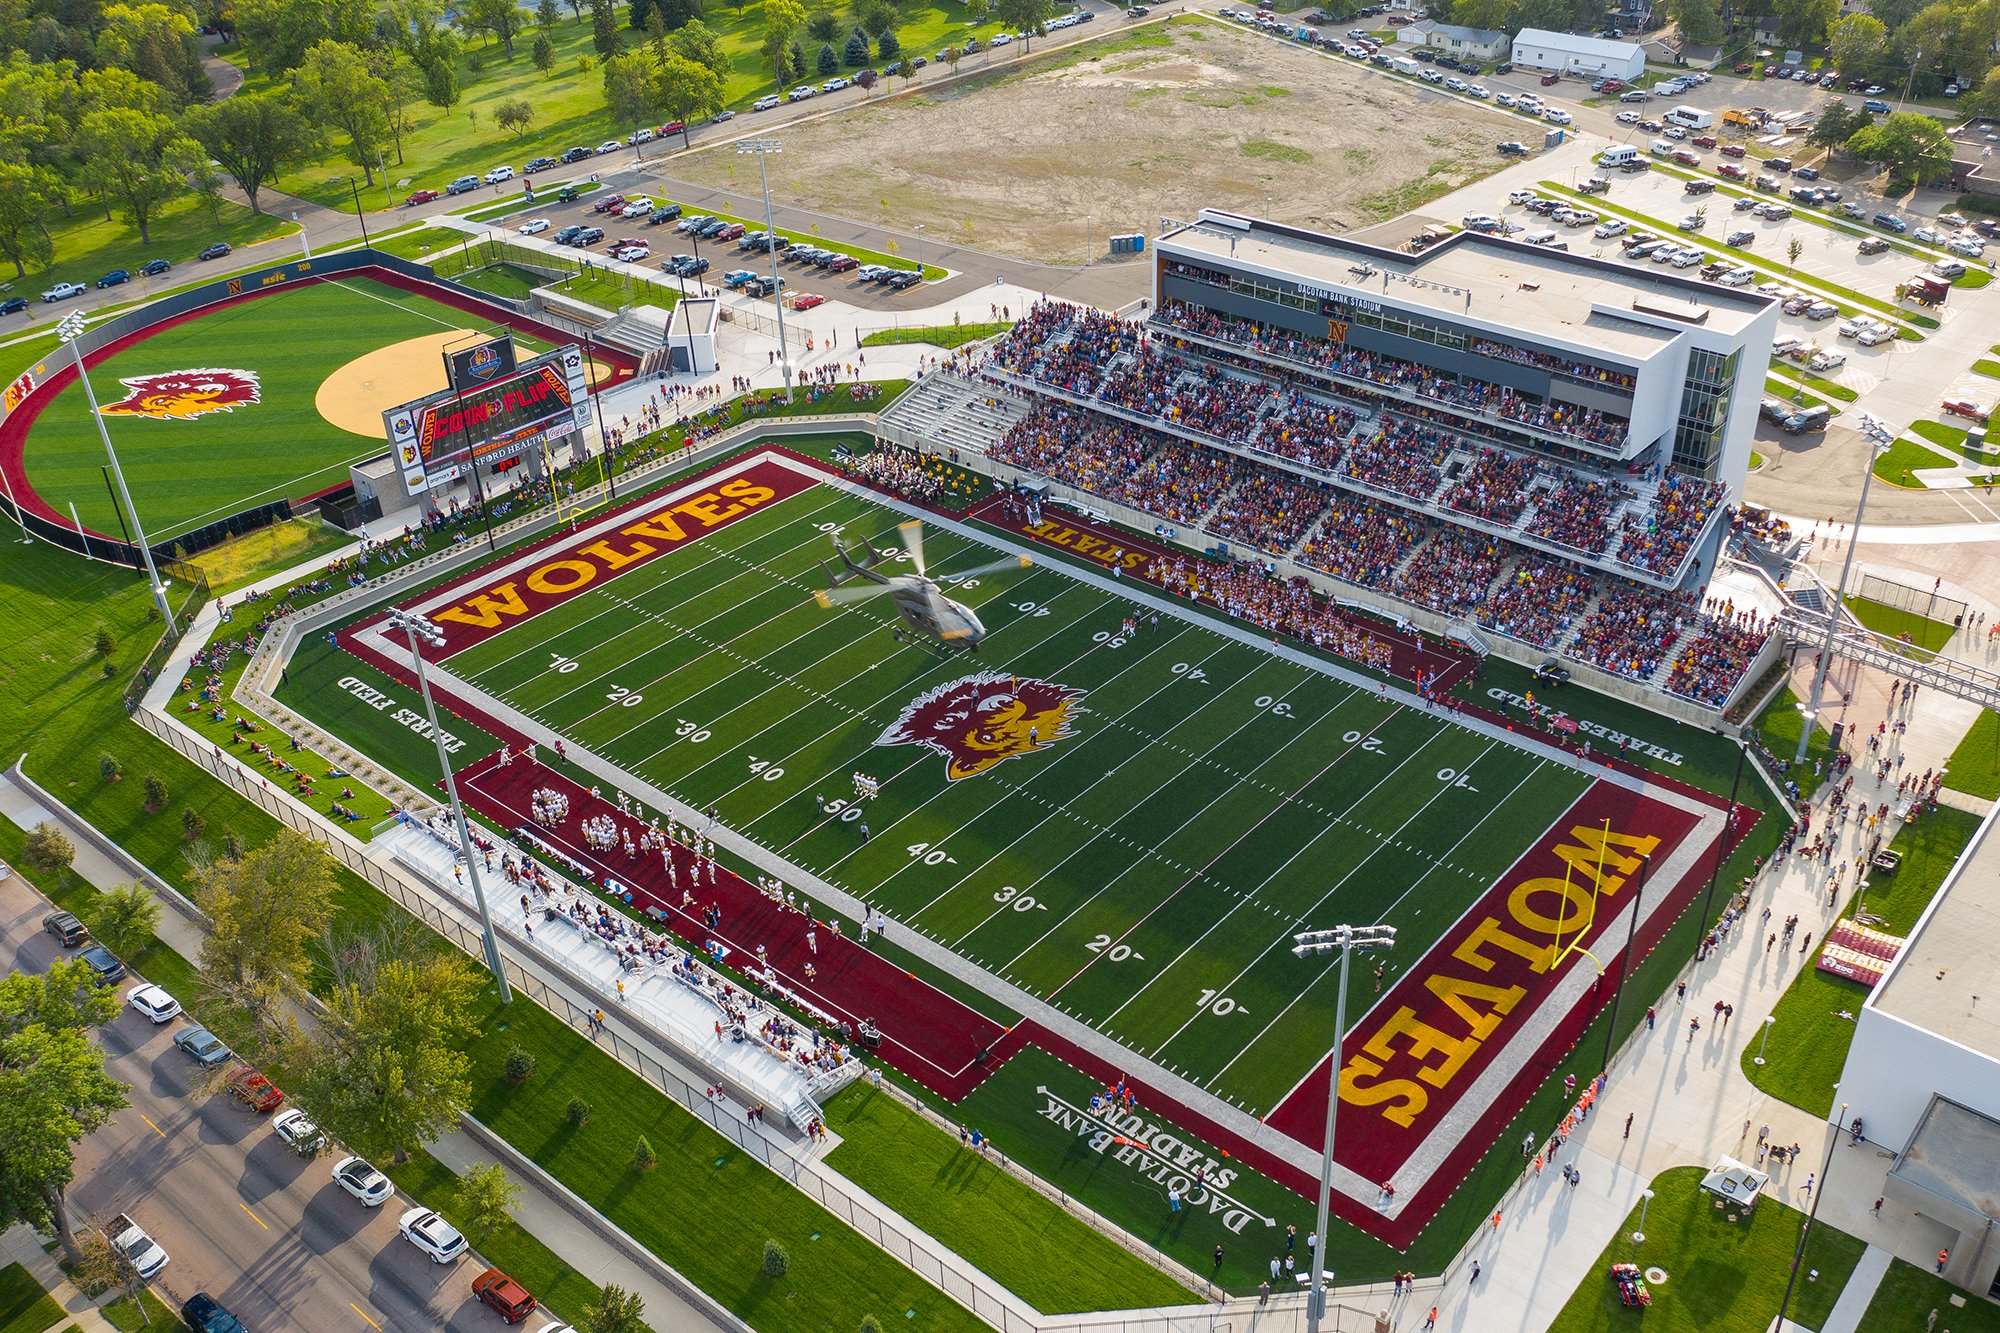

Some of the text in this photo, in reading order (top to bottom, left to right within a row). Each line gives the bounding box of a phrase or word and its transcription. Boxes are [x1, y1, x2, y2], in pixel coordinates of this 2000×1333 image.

[297, 262, 311, 271] 200
[227, 279, 243, 295] N
[1297, 284, 1381, 312] DACOTAH BANK STADIUM
[1328, 319, 1348, 344] N
[543, 370, 571, 403] WOLVES
[434, 380, 552, 439] COIN FLIP
[421, 412, 436, 457] WOLVES
[461, 449, 506, 473] SANFORD
[508, 433, 545, 455] HEALTH
[432, 479, 775, 629] WOLVES
[881, 547, 914, 562] 20
[1022, 519, 1148, 569] STATE
[1018, 601, 1051, 617] 40
[1092, 631, 1127, 649] 50
[549, 657, 579, 674] 10
[1170, 662, 1206, 680] 40
[606, 688, 643, 707] 20
[1254, 695, 1291, 715] 30
[337, 676, 467, 754] THARES FIELD
[675, 722, 711, 744] 30
[1342, 730, 1383, 751] 20
[1577, 720, 1684, 766] THARES
[748, 761, 784, 781] 40
[1436, 767, 1470, 787] 10
[822, 799, 861, 822] 50
[907, 842, 947, 865] 40
[993, 886, 1036, 912] 30
[1082, 935, 1131, 962] 20
[1337, 825, 1662, 1129] WOLVES
[1196, 989, 1236, 1016] 10
[1087, 1101, 1239, 1189] STADIUM
[1037, 1098, 1255, 1236] DACOTAH BANK
